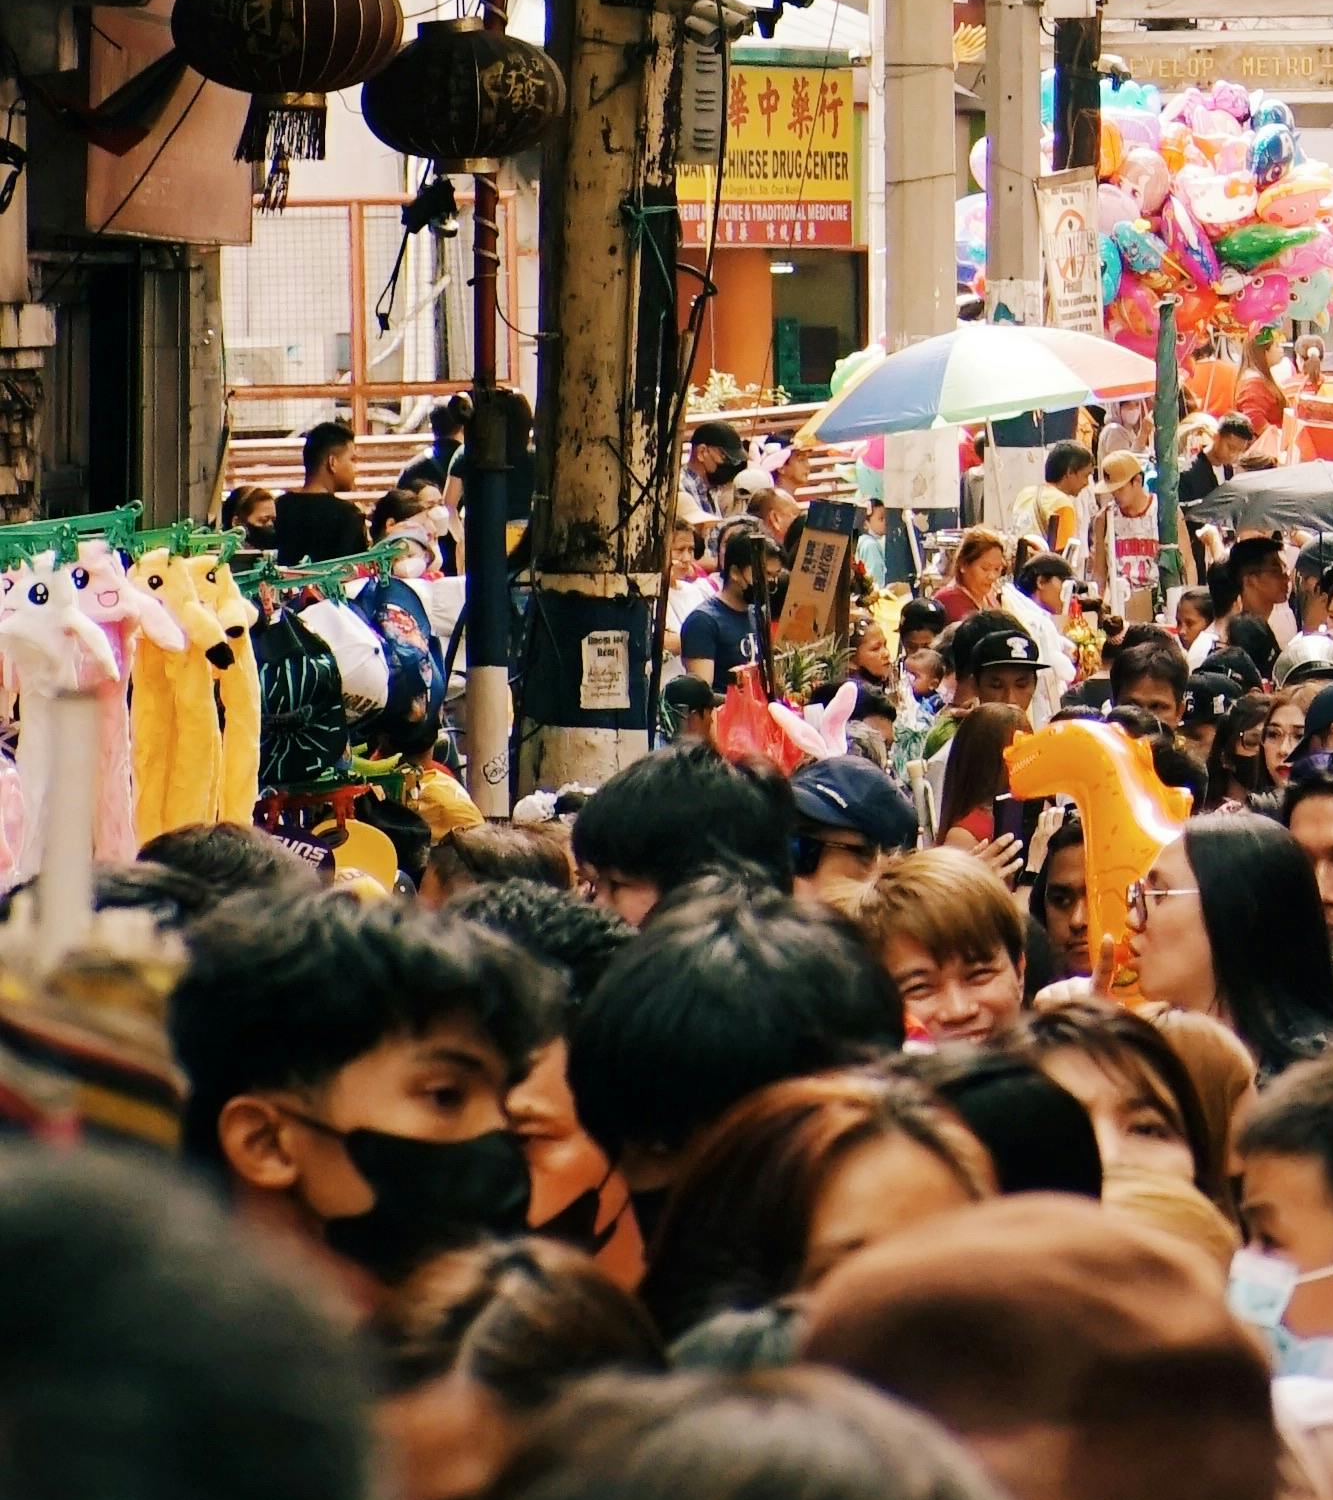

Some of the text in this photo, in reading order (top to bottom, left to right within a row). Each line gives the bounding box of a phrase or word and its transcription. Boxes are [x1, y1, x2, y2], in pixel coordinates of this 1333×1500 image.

[1129, 57, 1215, 79] EVELOP
[1241, 55, 1313, 77] METRO
[772, 150, 801, 180] DRUG
[805, 150, 849, 181] CENTER
[752, 203, 806, 221] TRADITIONAL
[808, 204, 848, 221] MEDICINE
